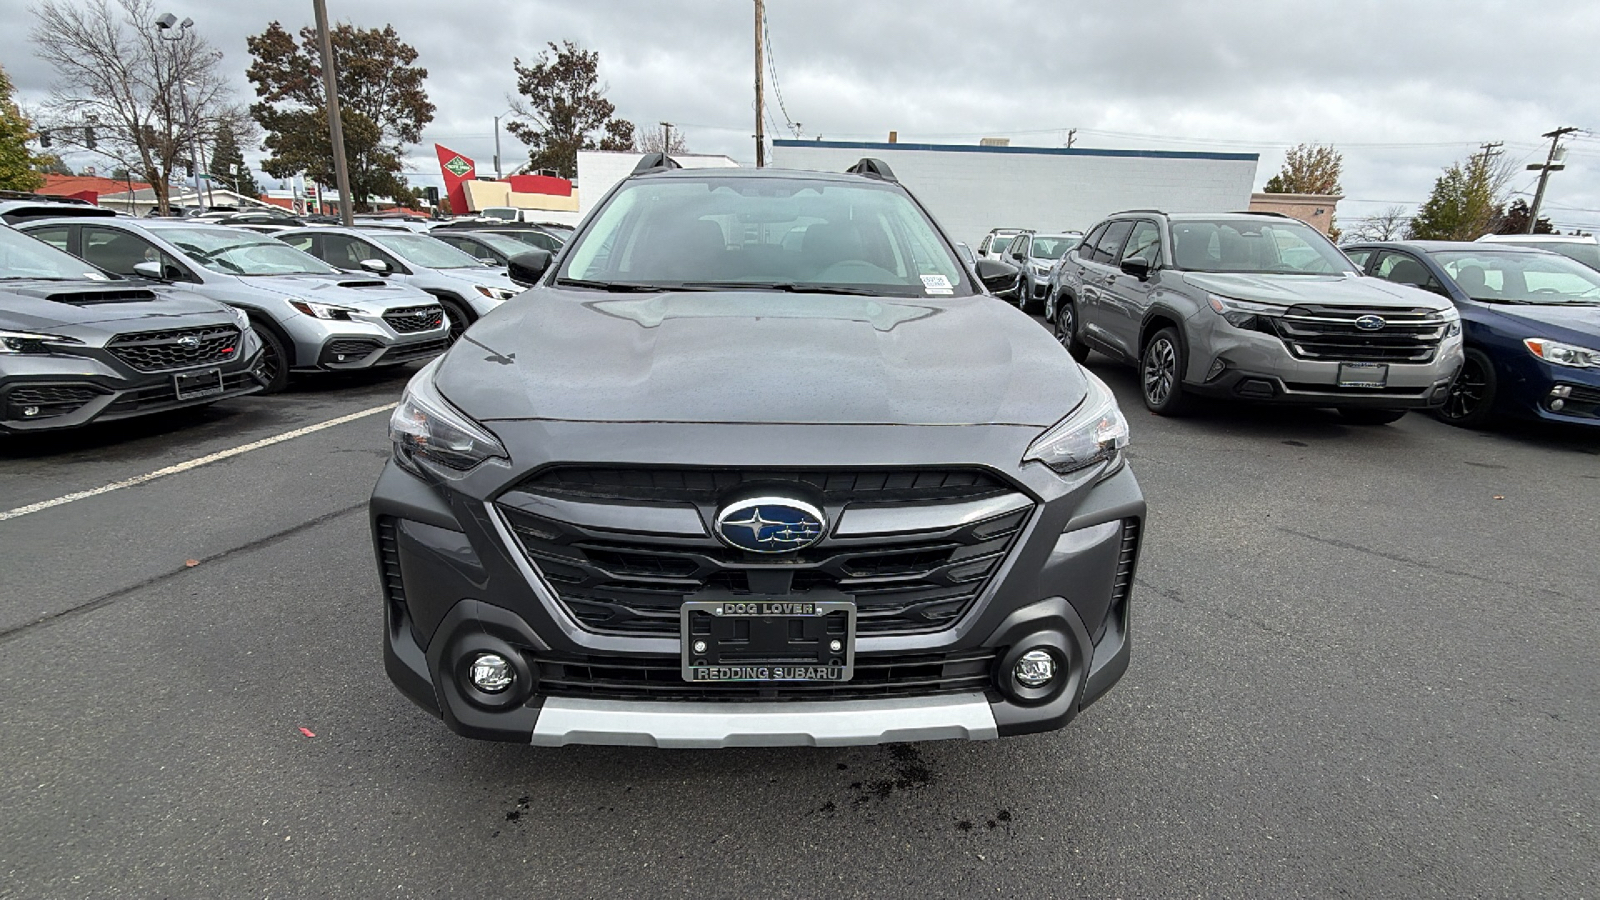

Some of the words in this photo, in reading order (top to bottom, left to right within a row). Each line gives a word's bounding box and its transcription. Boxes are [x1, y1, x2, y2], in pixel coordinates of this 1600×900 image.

[724, 603, 758, 615] DOG
[763, 603, 813, 614] LOVER
[697, 667, 769, 680] REDDING
[773, 667, 838, 679] SUBARU
